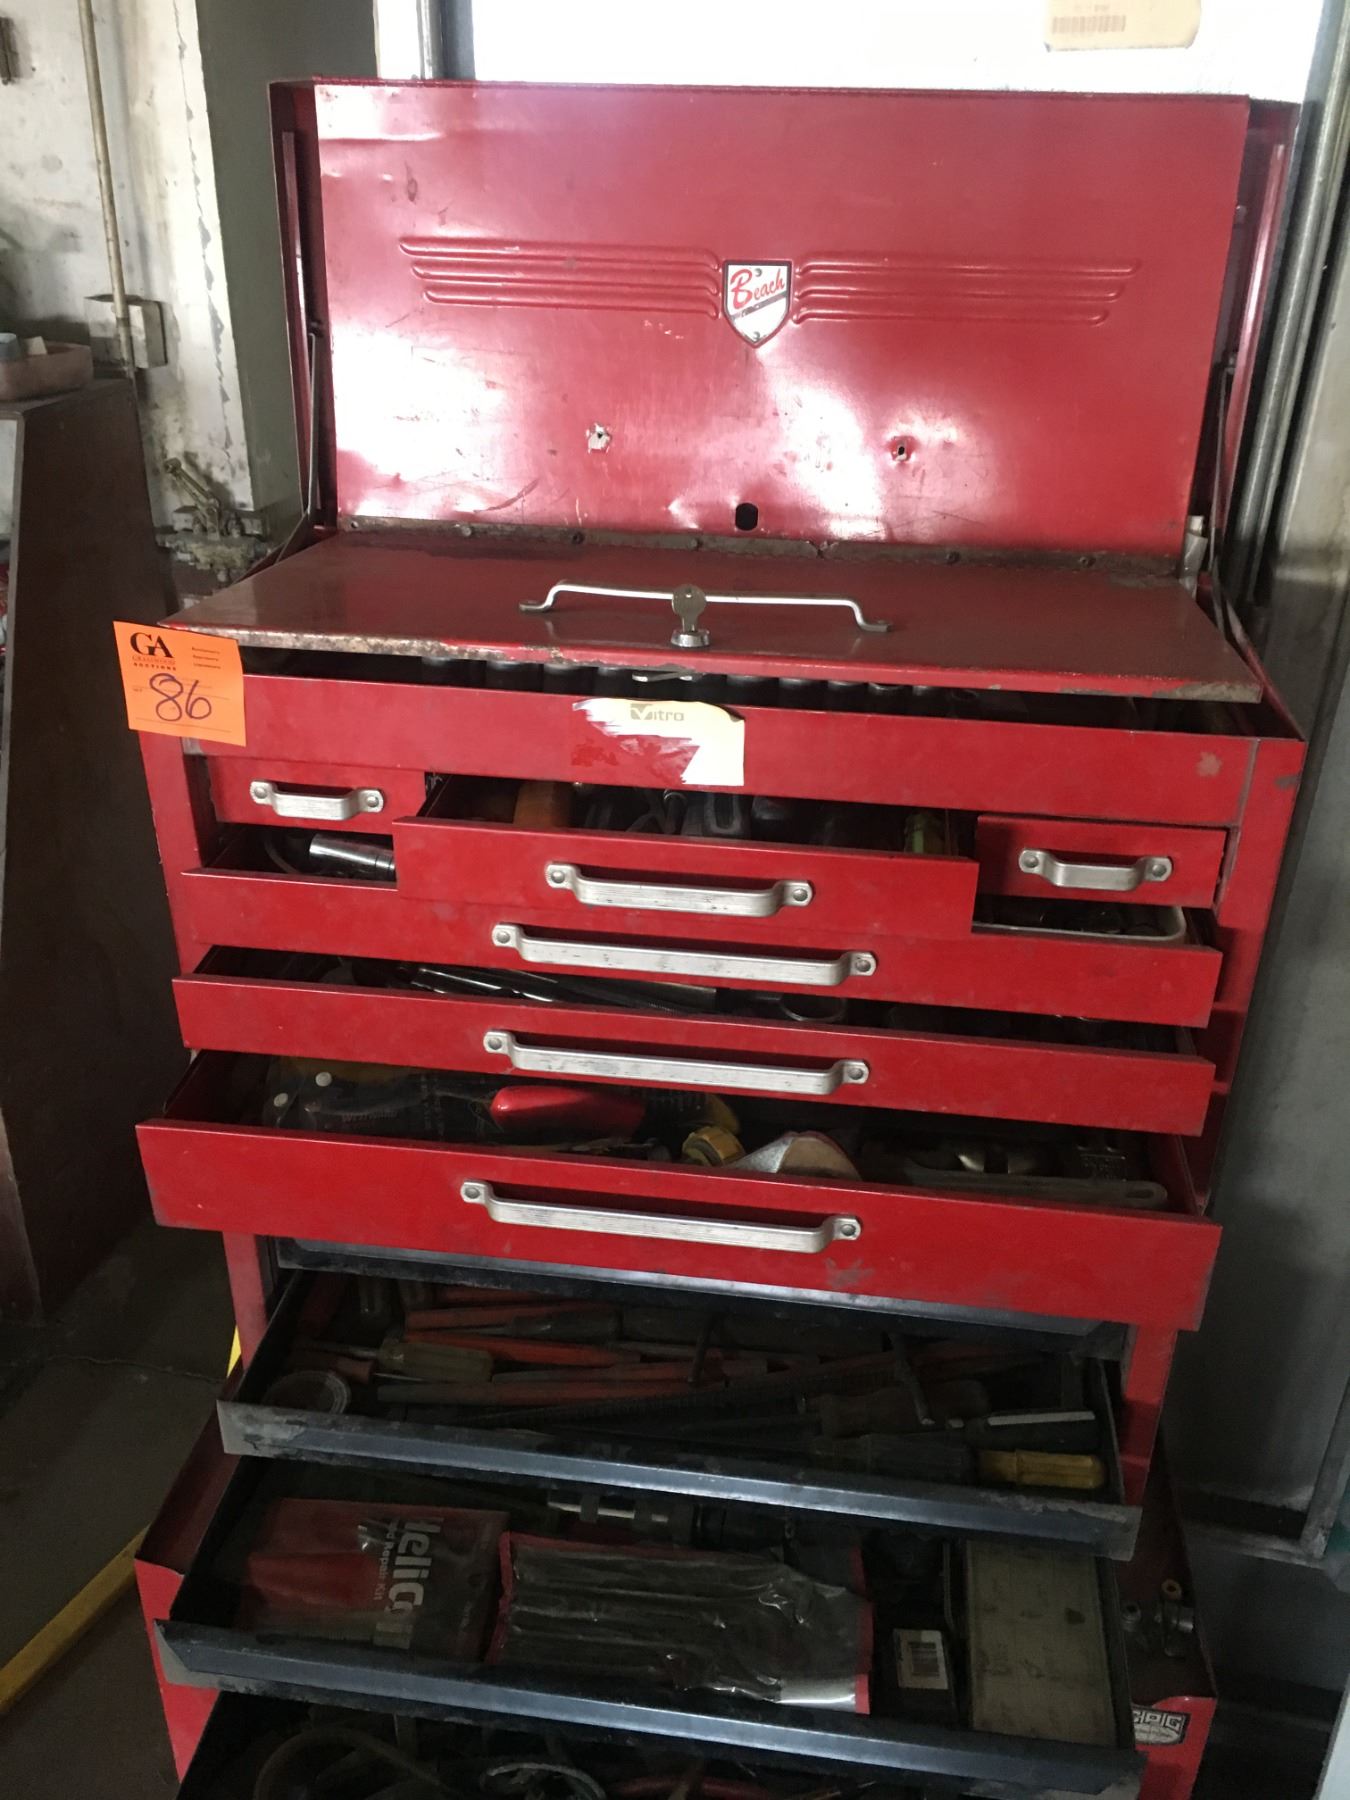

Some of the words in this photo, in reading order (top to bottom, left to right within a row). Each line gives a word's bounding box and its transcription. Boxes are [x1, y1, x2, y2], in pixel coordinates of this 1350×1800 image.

[730, 269, 785, 309] Beach
[130, 632, 174, 658] GA
[150, 673, 211, 721] 86
[631, 703, 685, 721] Vitro
